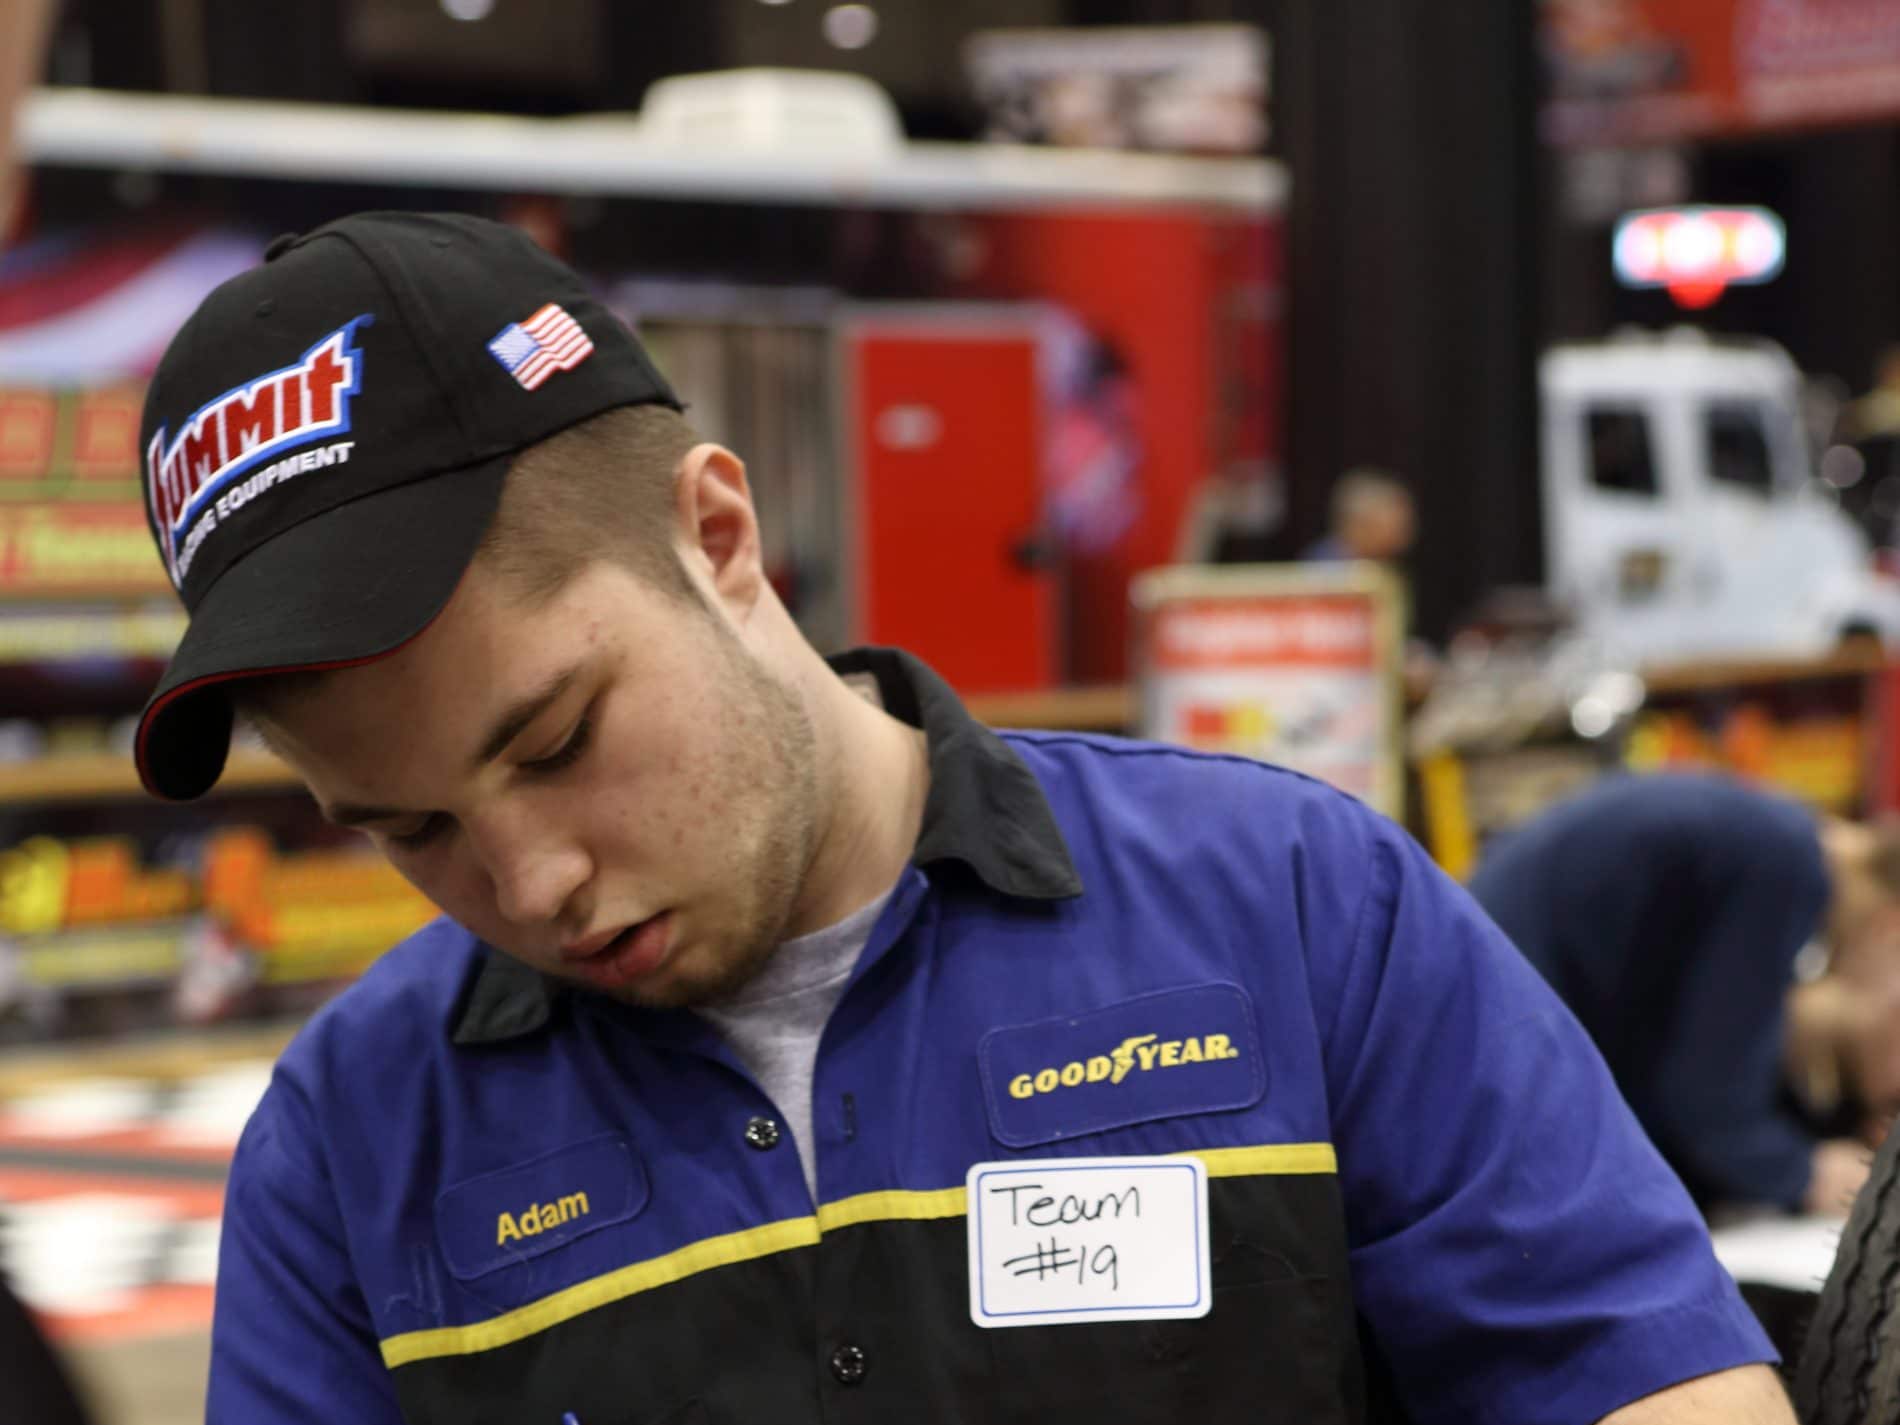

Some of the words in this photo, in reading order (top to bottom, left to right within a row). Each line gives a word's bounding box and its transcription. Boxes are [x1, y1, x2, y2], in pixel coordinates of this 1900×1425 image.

[216, 441, 355, 519] EQUIPMENT
[496, 1190, 592, 1246] Adam
[990, 1185, 1141, 1227] Team
[1003, 1236, 1119, 1291] #19
